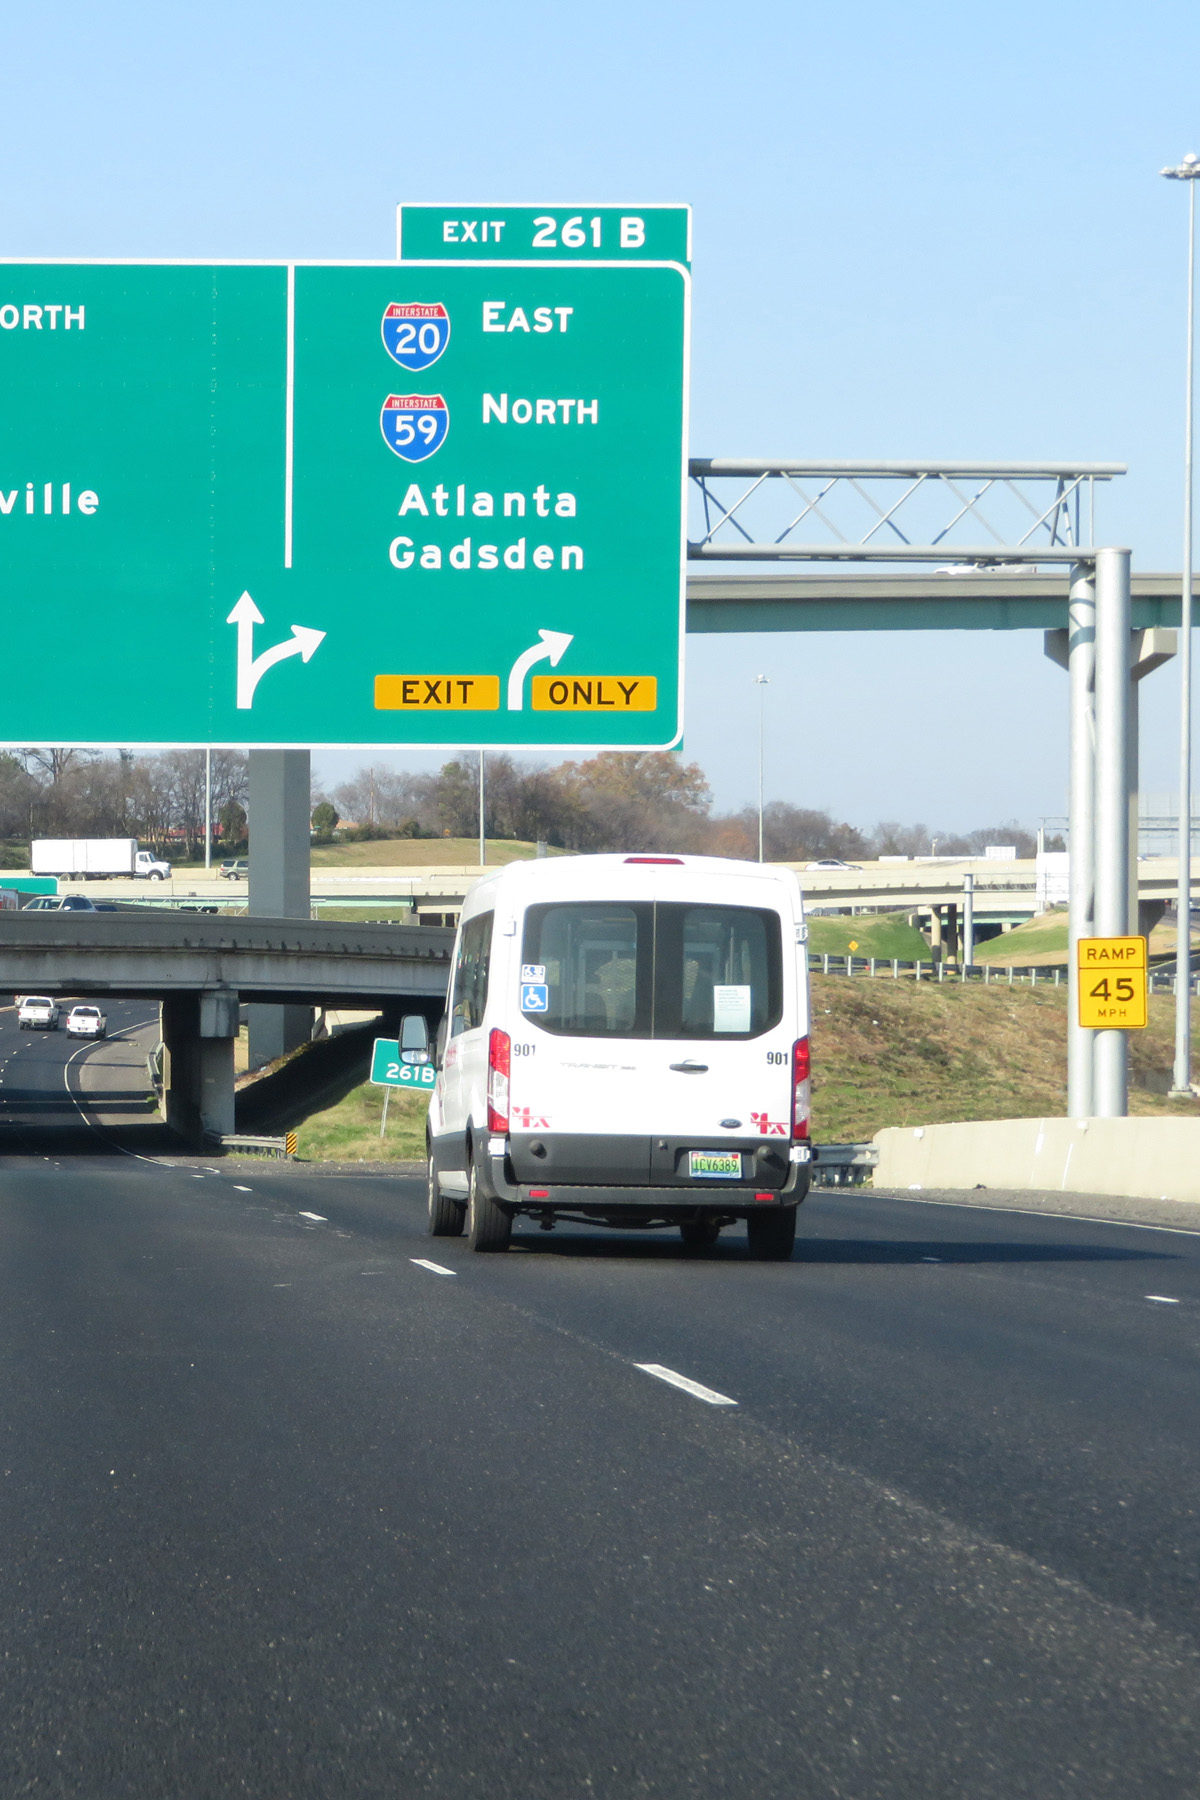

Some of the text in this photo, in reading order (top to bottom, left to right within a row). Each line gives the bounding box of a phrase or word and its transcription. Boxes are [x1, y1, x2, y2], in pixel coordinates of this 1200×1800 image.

[443, 216, 646, 248] EXIT 261 B
[392, 308, 439, 317] INTERSTATE
[482, 301, 574, 333] EAST
[395, 323, 440, 355] 20
[391, 399, 438, 408] INTERSTATE
[482, 393, 598, 425] NORTH
[395, 414, 438, 446] 59
[398, 483, 577, 518] Atlanta
[389, 536, 584, 571] Gadsden
[402, 680, 639, 705] EXIT ONLY
[1086, 947, 1137, 961] RAMP
[1089, 977, 1135, 1002] 45
[1097, 1008, 1128, 1018] MPH
[513, 1043, 536, 1057] 901
[766, 1051, 789, 1066] 901
[385, 1062, 435, 1083] 261B
